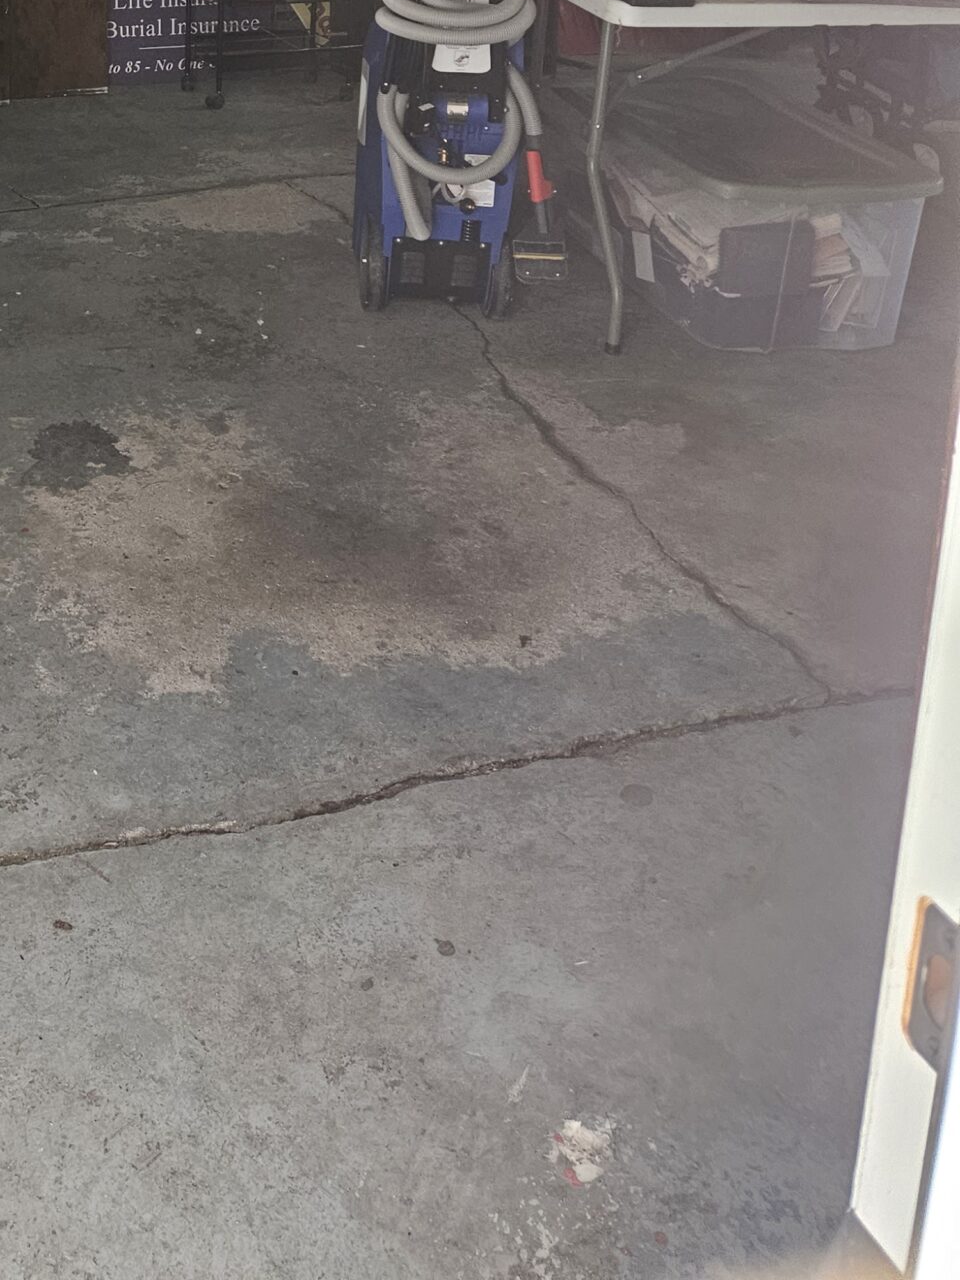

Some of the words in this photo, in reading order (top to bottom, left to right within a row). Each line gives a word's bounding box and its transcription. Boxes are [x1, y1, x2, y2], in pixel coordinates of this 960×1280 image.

[107, 18, 162, 39] Burial
[108, 62, 121, 74] to
[124, 60, 142, 73] 85
[154, 59, 174, 72] No
